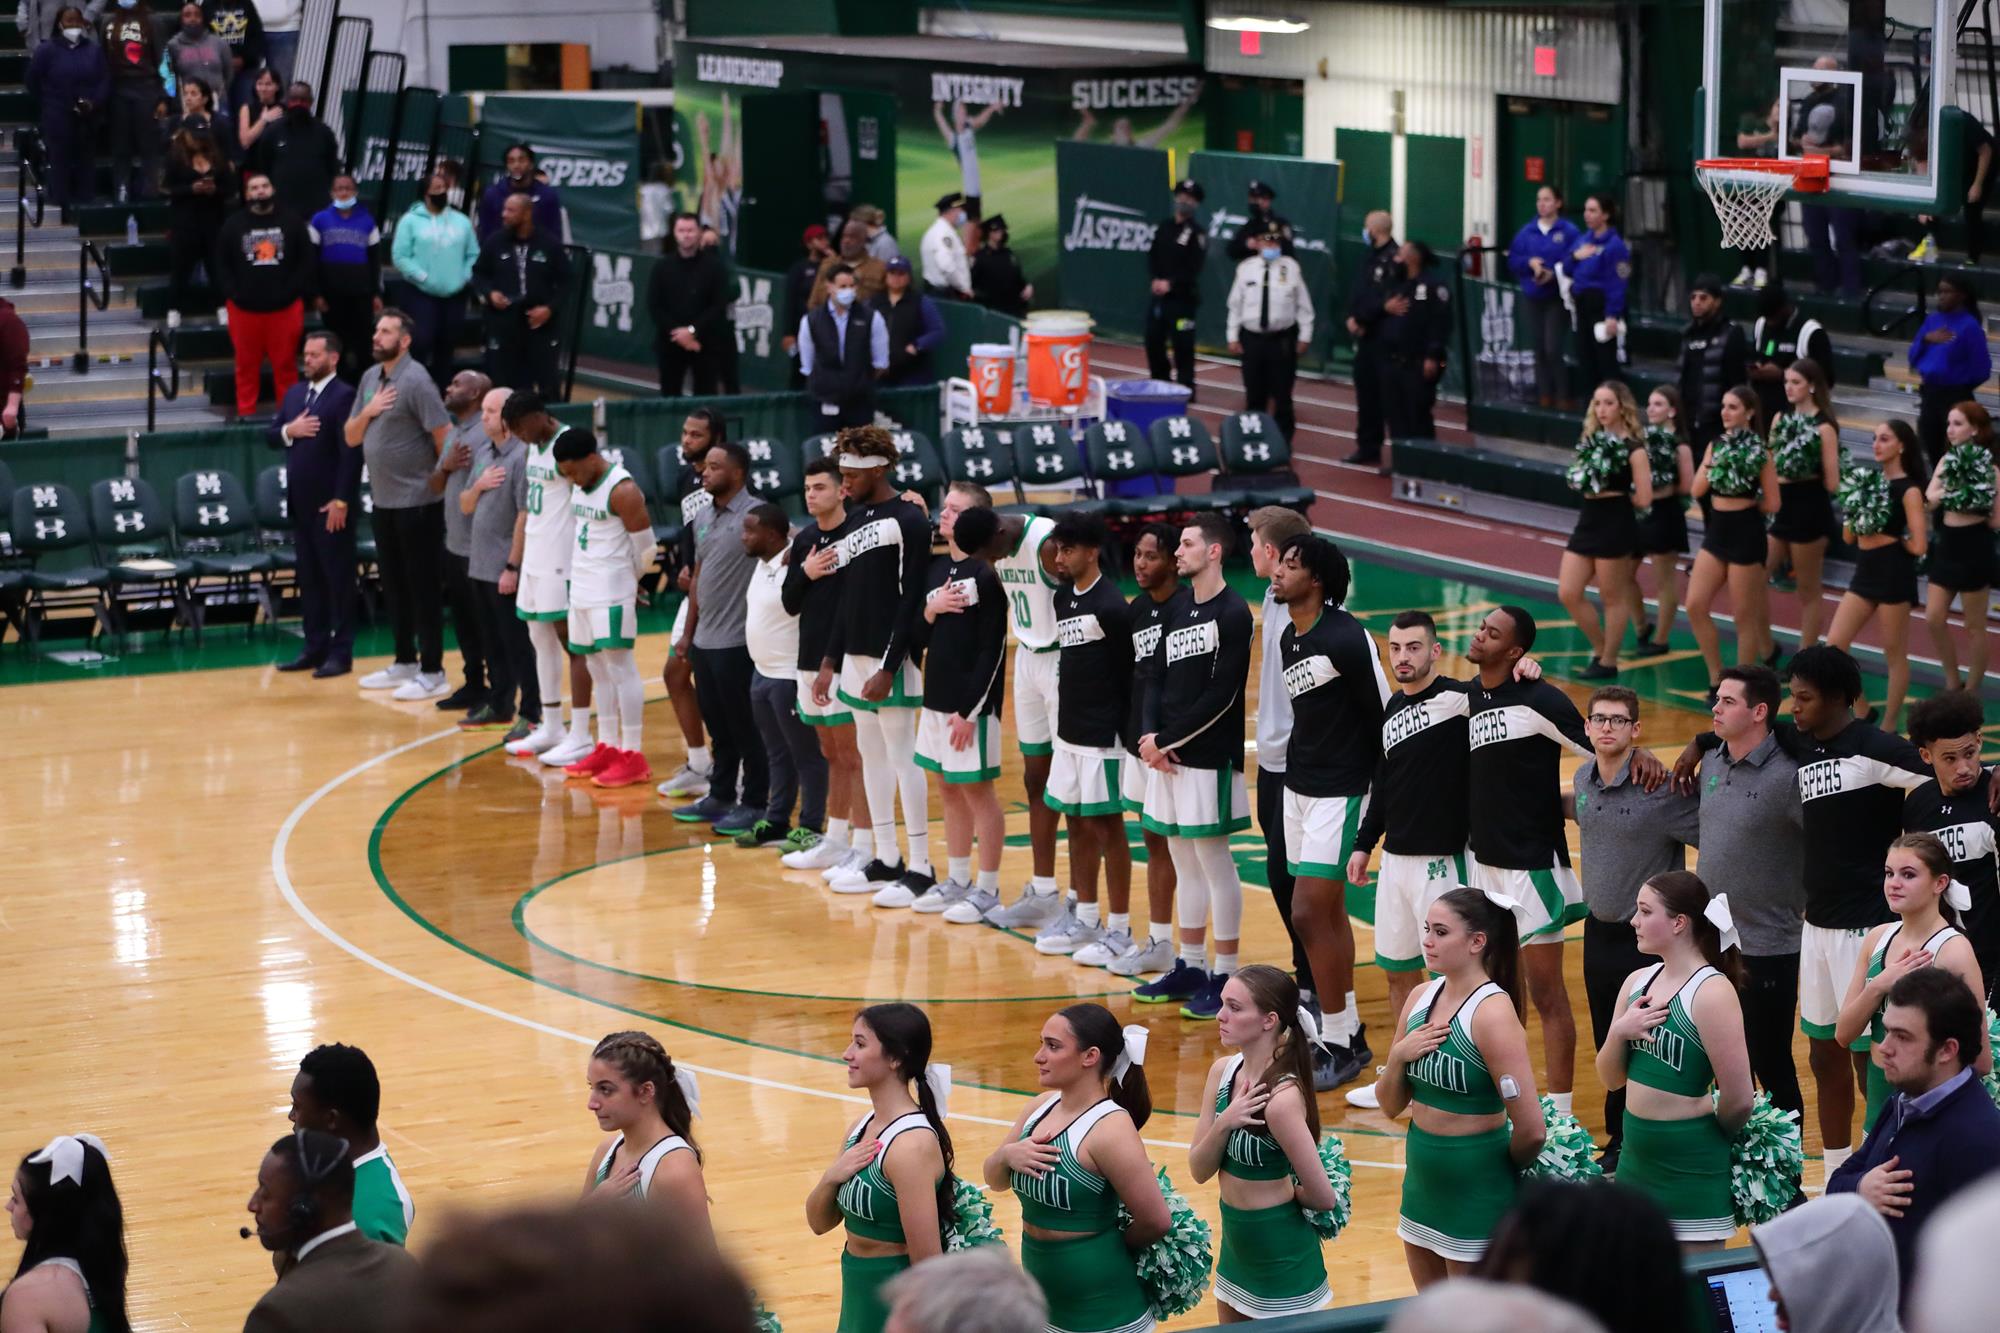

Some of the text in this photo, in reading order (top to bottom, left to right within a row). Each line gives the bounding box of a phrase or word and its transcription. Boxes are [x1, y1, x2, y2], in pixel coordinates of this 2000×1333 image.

[697, 53, 784, 89] LEADERSHIP
[931, 72, 1025, 108] INTEGRITY
[1072, 77, 1198, 110] SUCCESS
[538, 156, 629, 187] SPERS
[983, 363, 1000, 380] G
[1063, 347, 1081, 369] G
[33, 486, 58, 508] M
[110, 479, 136, 502] M
[196, 472, 222, 495] M
[578, 521, 588, 551] 4
[1011, 589, 1032, 629] 10
